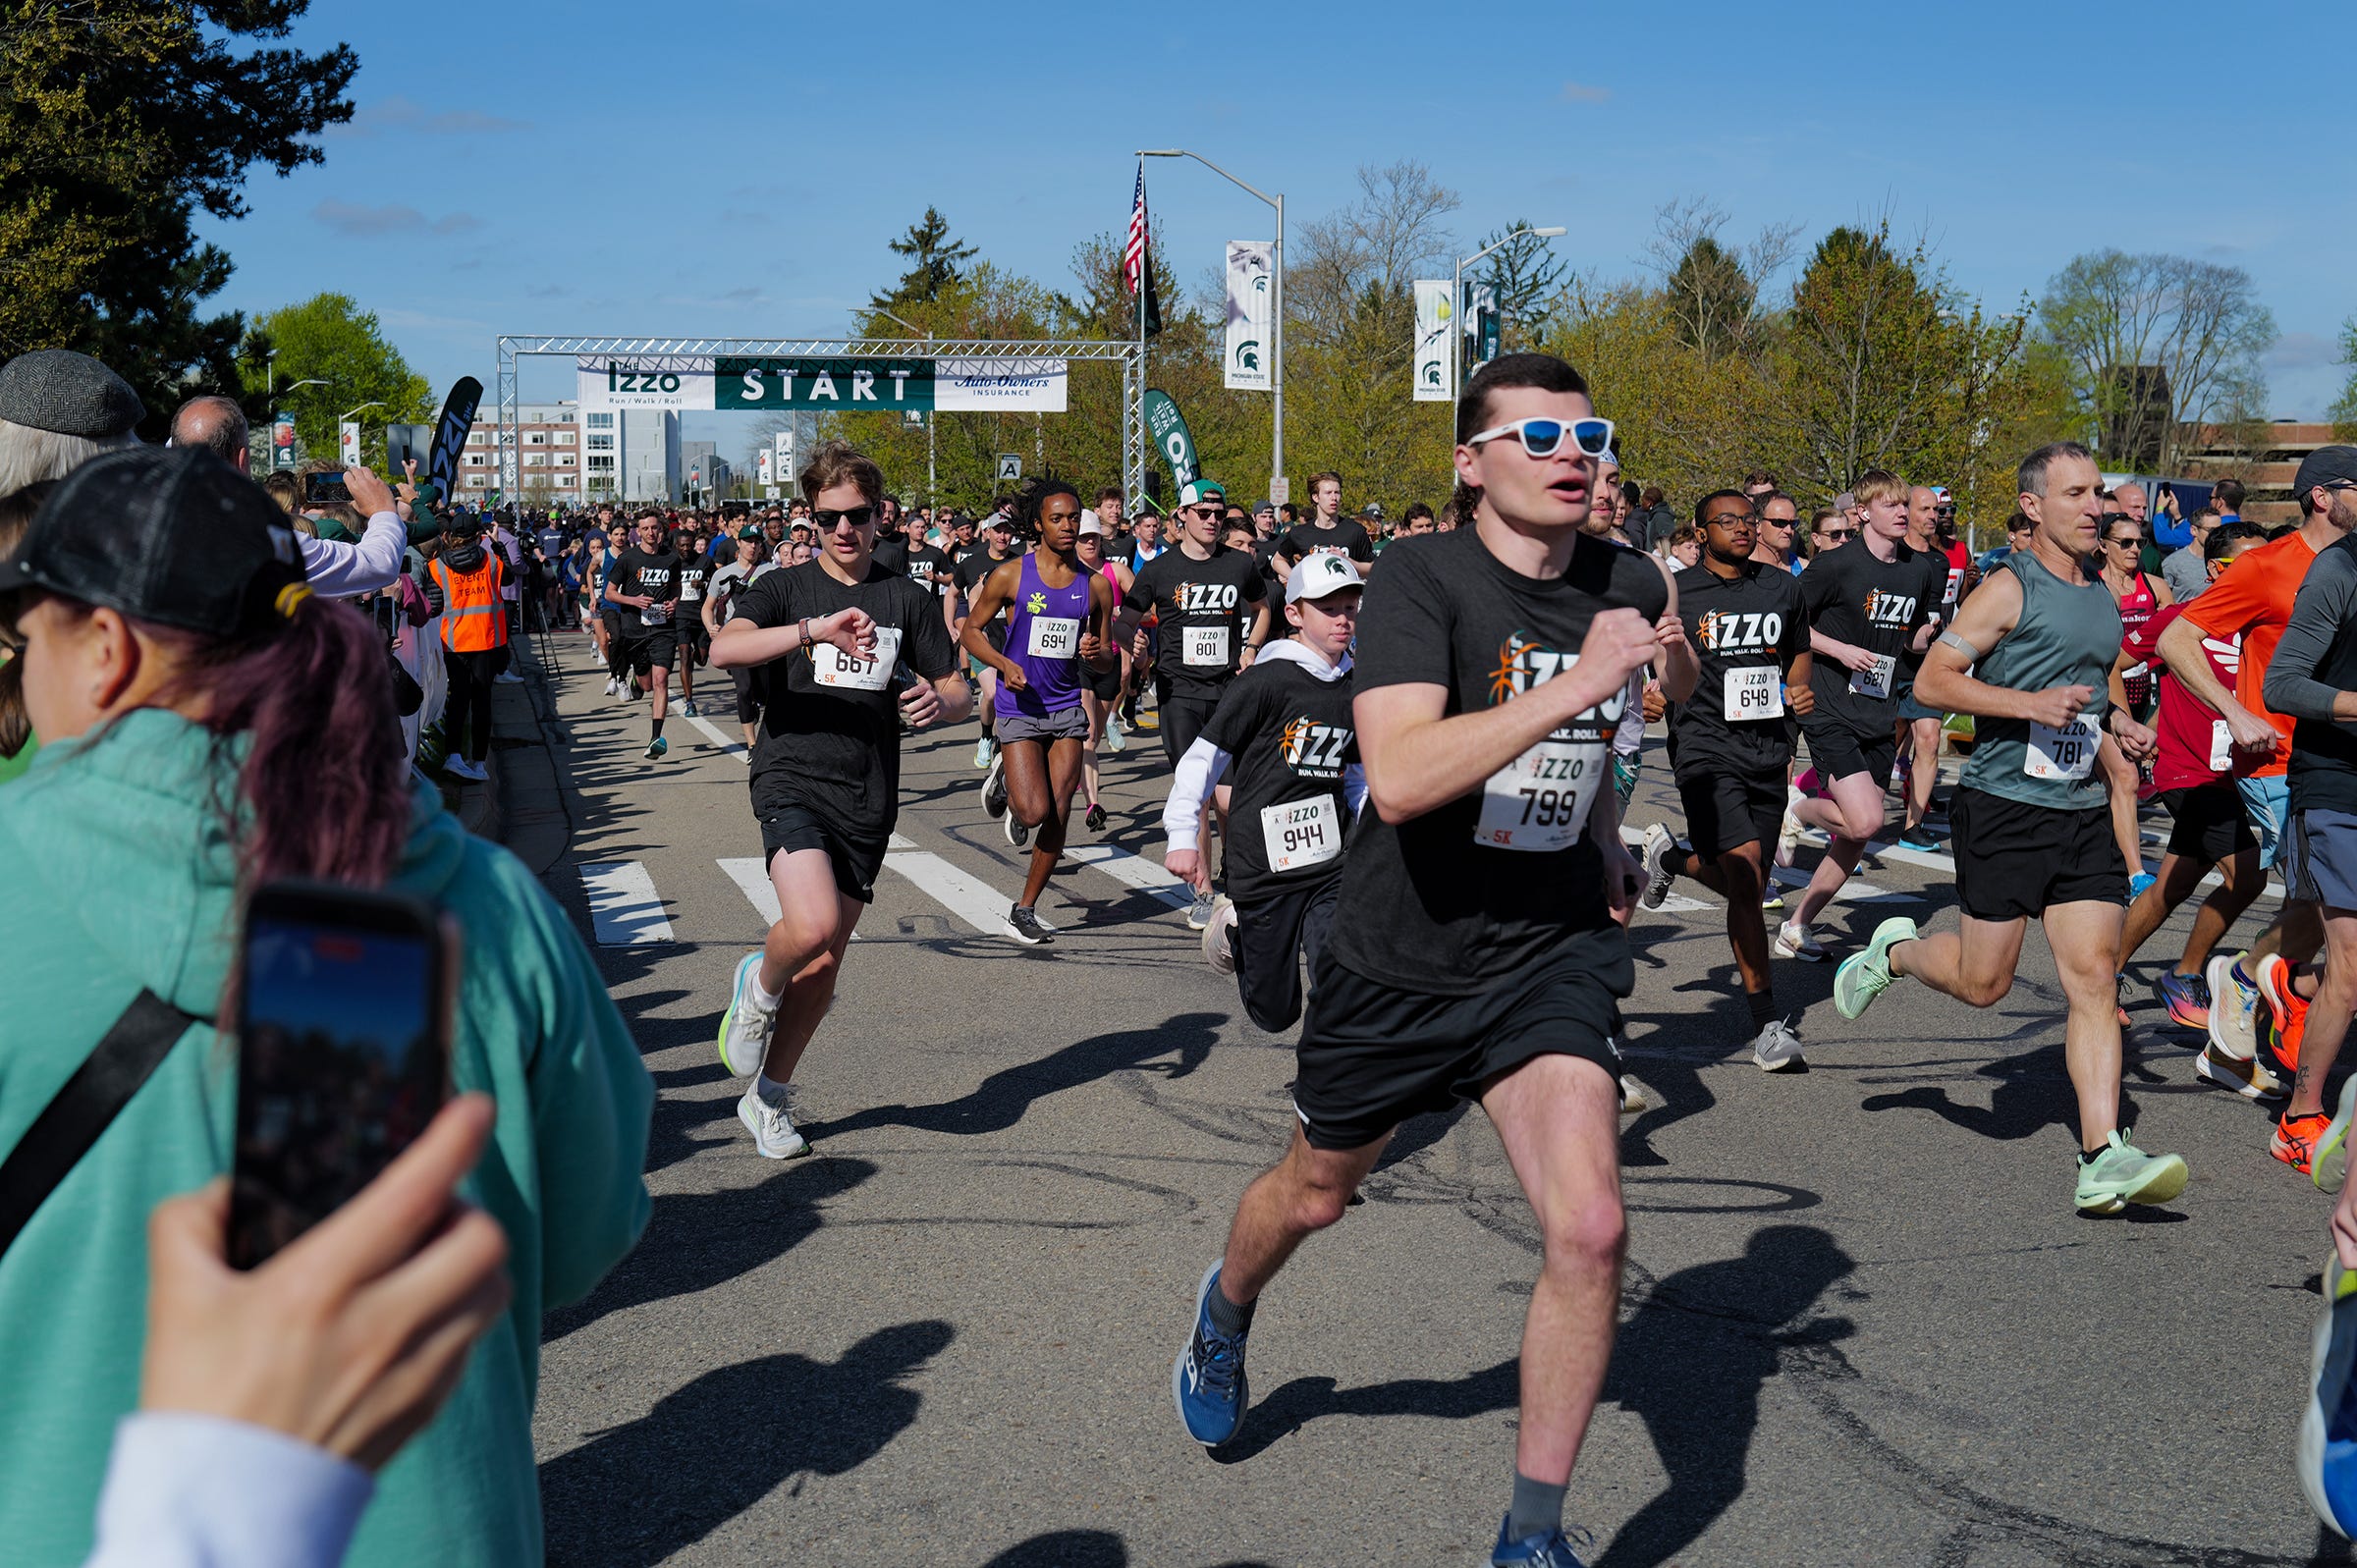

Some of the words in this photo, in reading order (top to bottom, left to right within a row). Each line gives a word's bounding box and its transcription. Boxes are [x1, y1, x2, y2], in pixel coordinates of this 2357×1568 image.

[740, 368, 910, 401] START
[955, 374, 1049, 389] Auto-Owners
[1155, 403, 1170, 431] Walk
[1164, 401, 1178, 424] Roll
[1150, 415, 1163, 438] Run
[1002, 462, 1016, 476] A
[454, 573, 485, 585] EVENT
[682, 569, 703, 582] ZZO
[459, 586, 486, 597] TEAM
[1041, 634, 1067, 649] 694
[1196, 642, 1217, 656] 801
[836, 650, 876, 675] 667
[1875, 660, 1889, 670] ZZO
[825, 674, 836, 683] 5K
[1863, 671, 1886, 688] 627
[1740, 688, 1769, 707] 649
[1732, 710, 1742, 719] 5K
[1572, 729, 1600, 740] ROLL.
[1288, 725, 1353, 768] IZZ
[2053, 740, 2082, 764] 781
[2035, 765, 2047, 775] 5K
[1519, 787, 1576, 826] 799
[1284, 823, 1324, 852] 944
[1494, 830, 1512, 844] 5K
[1279, 856, 1289, 867] 5K
